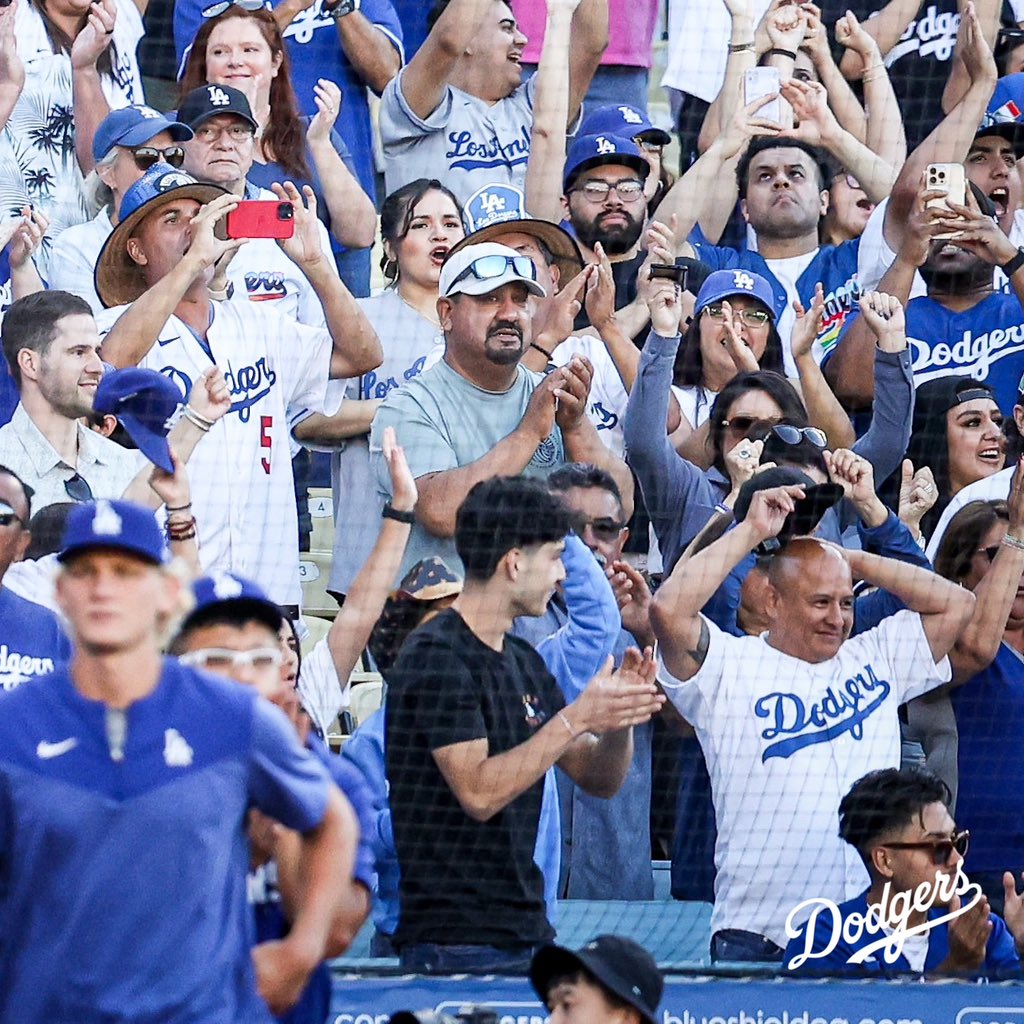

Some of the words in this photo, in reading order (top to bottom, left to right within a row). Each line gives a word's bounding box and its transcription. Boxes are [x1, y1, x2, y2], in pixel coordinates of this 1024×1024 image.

[208, 86, 230, 106] LA
[446, 131, 488, 158] Los
[595, 137, 616, 154] LA
[480, 192, 506, 214] LA
[733, 271, 754, 290] LA
[318, 502, 325, 512] 4
[299, 565, 307, 576] 3
